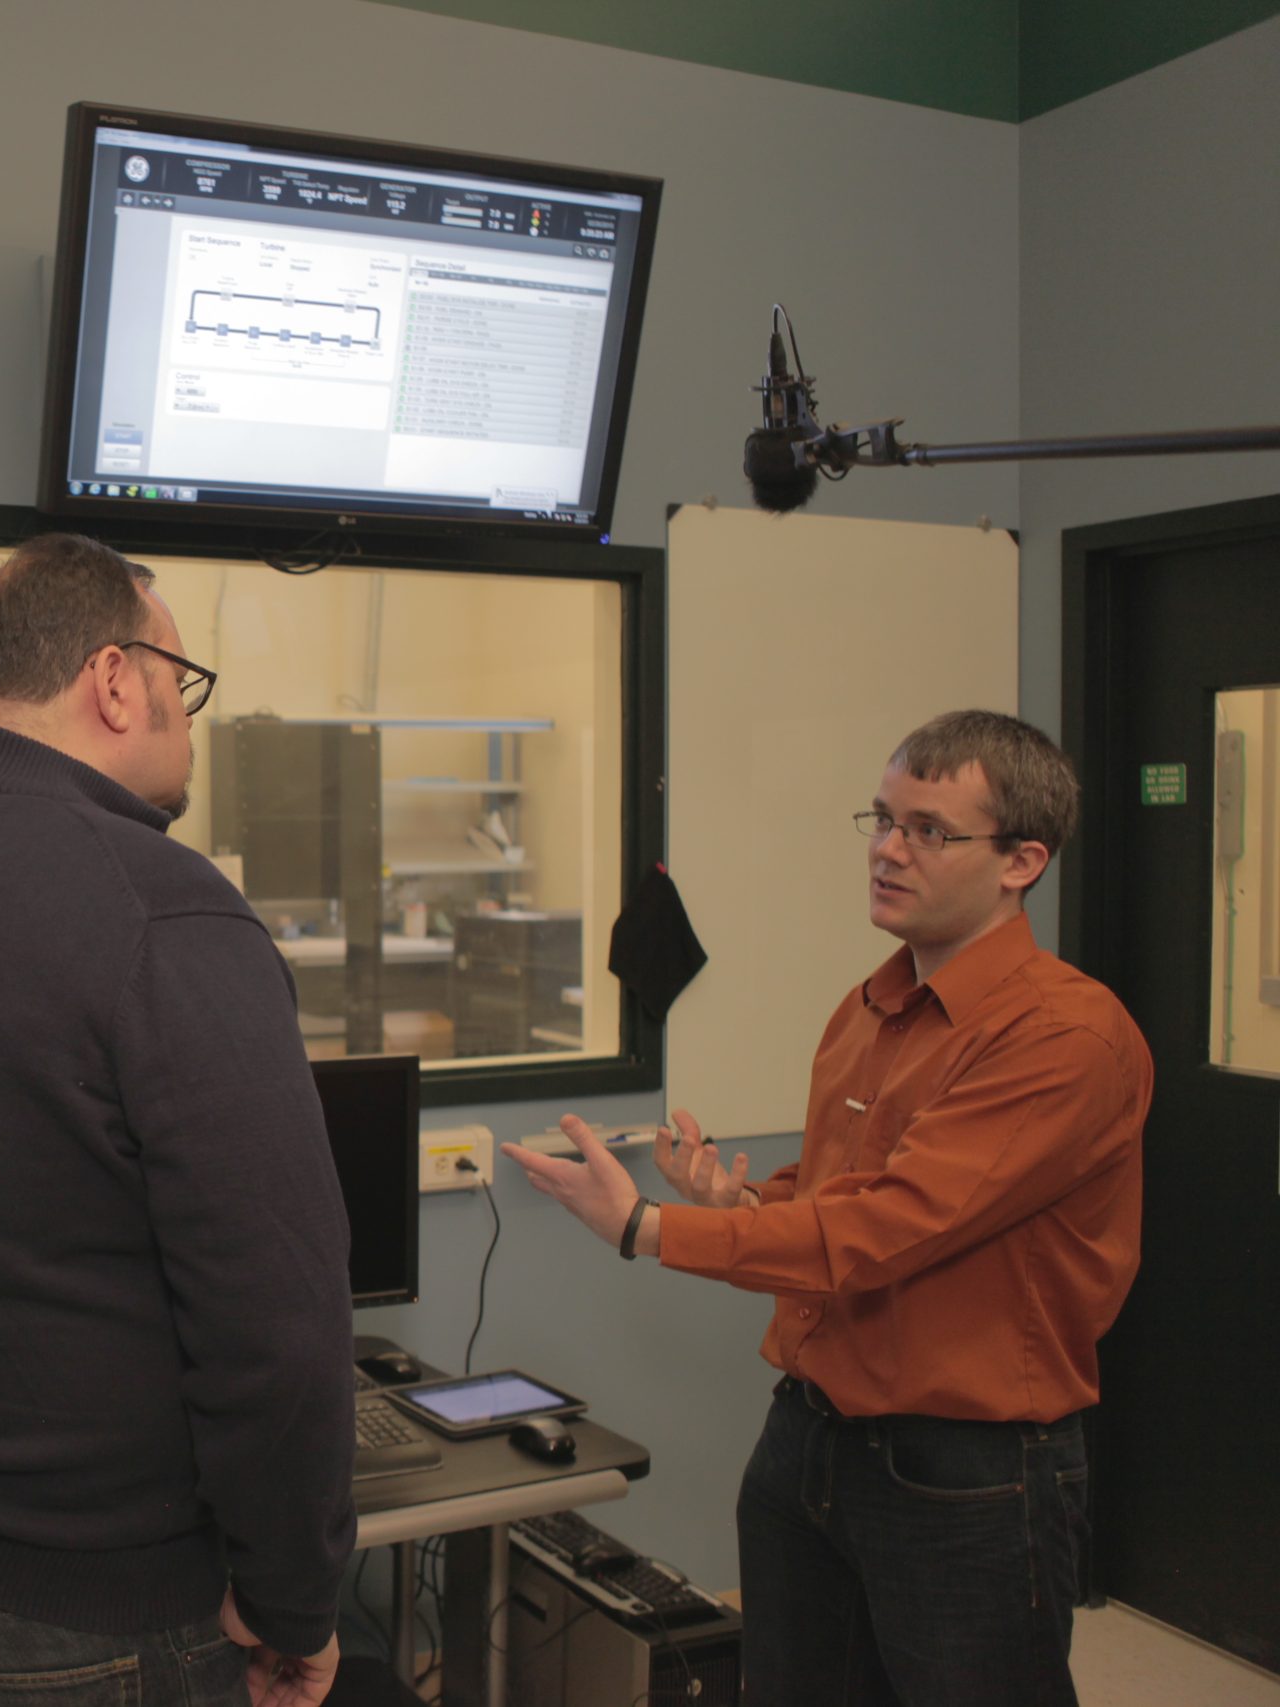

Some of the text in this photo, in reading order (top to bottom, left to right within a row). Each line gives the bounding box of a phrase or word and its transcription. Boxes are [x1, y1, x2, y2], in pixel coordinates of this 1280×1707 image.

[344, 194, 368, 206] Speed
[188, 234, 241, 248] Start Sequence
[260, 241, 286, 252] Turbine
[415, 259, 466, 272] Sequence Detail
[175, 372, 201, 382] Control
